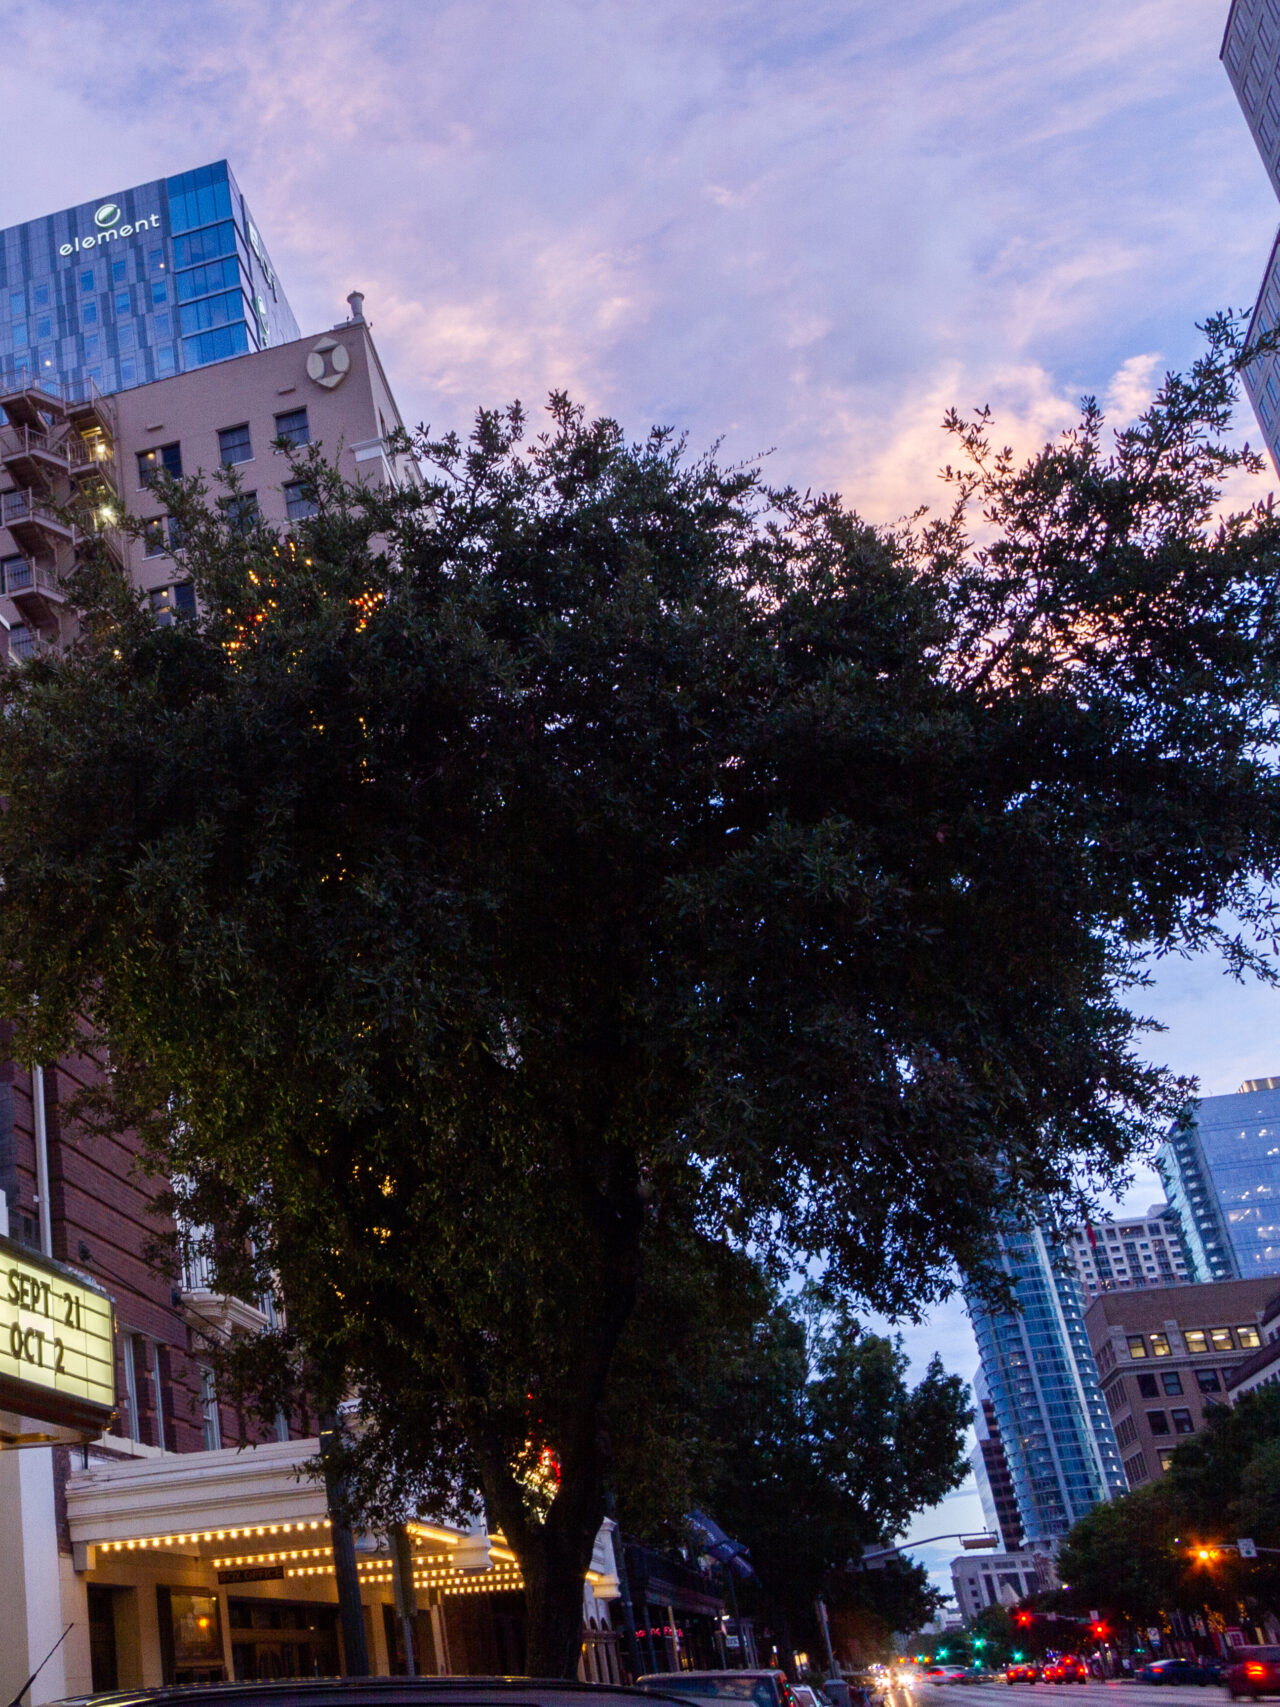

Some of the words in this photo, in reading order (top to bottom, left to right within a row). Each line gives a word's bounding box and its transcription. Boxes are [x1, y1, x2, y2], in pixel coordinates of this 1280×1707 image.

[59, 213, 160, 256] element
[7, 1268, 51, 1319] SEPT
[63, 1292, 82, 1330] 21
[10, 1321, 45, 1368] OCT
[54, 1336, 66, 1375] 2
